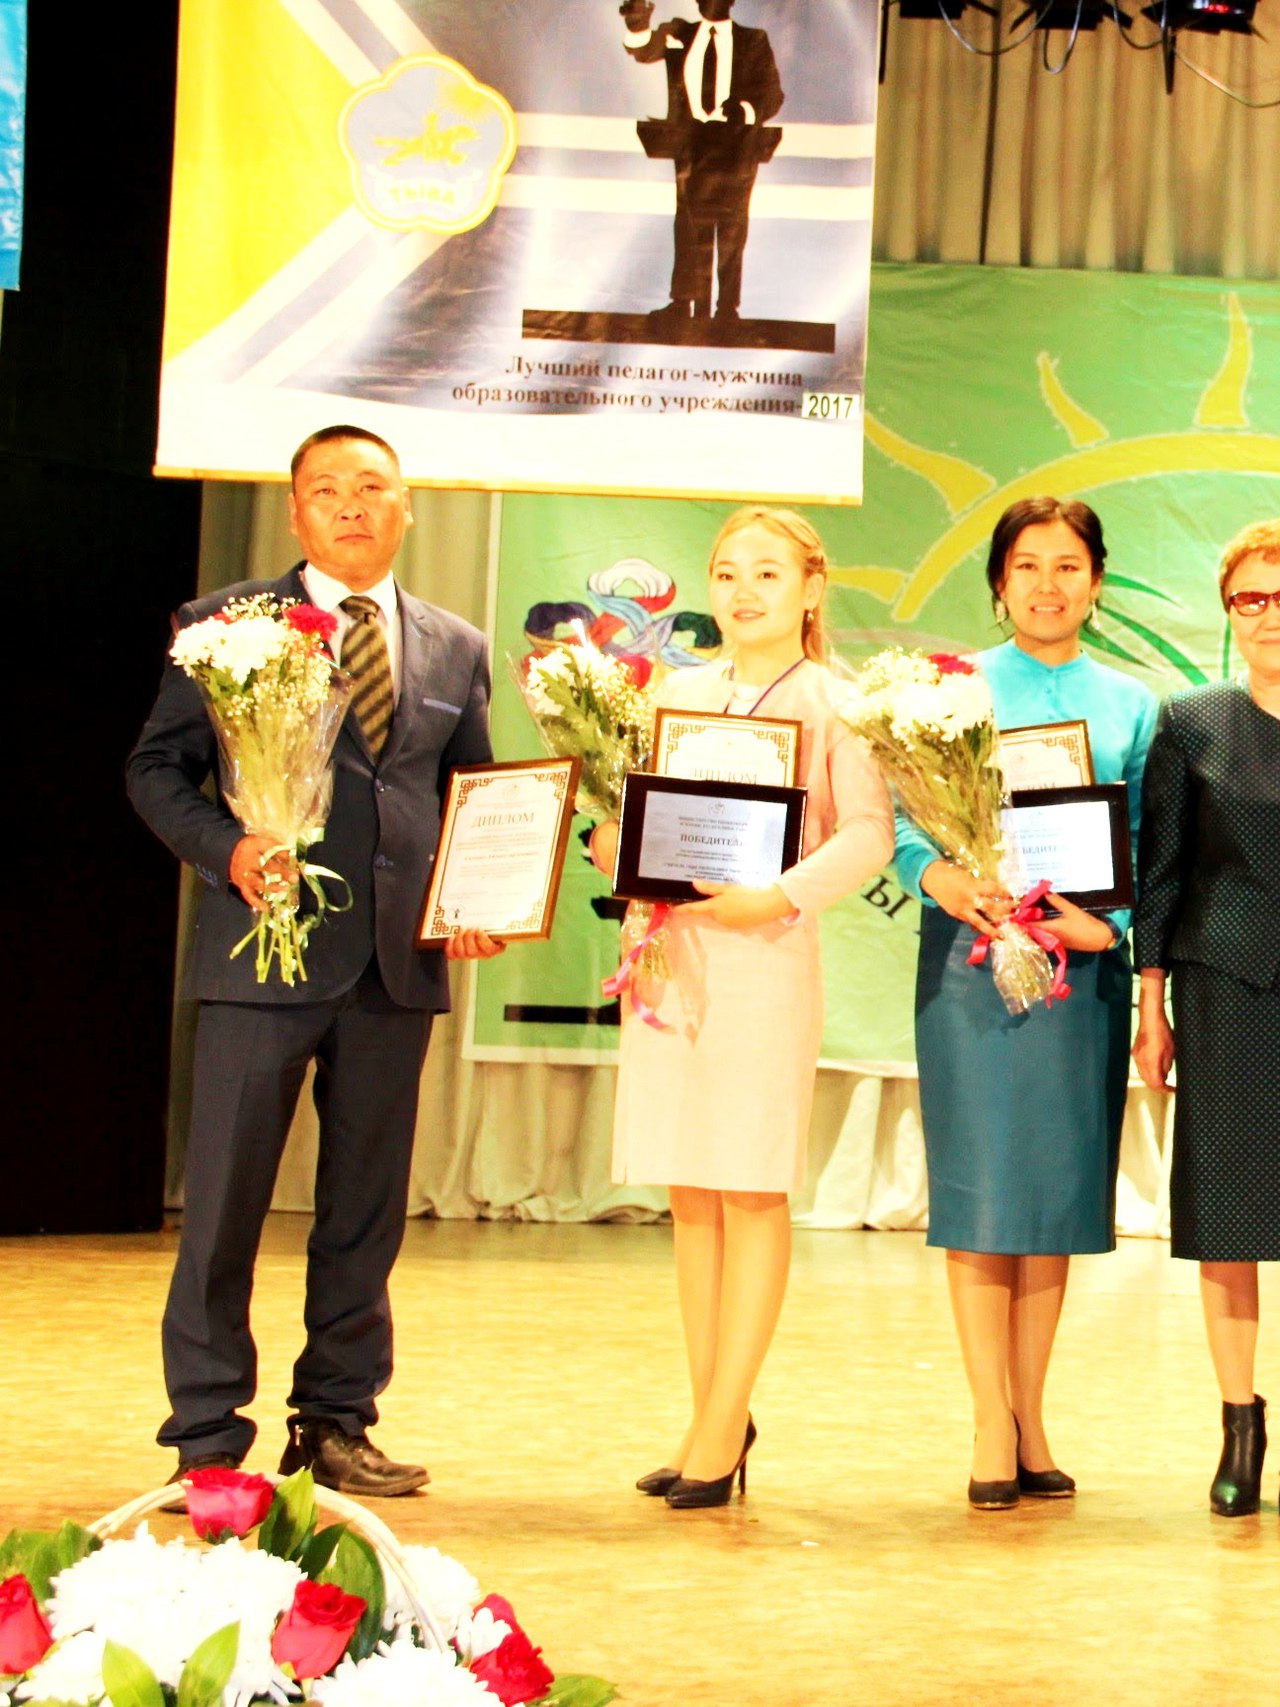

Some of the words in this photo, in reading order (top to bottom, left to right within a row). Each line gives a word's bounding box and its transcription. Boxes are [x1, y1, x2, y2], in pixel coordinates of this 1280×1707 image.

[505, 355, 601, 379] Лучший
[607, 364, 802, 388] педагог-мужчина
[452, 385, 652, 409] образовательного
[808, 394, 854, 420] 2017
[470, 811, 535, 828] ДИПЛОМ
[680, 833, 746, 848] ПОБЕДИТЕЛ
